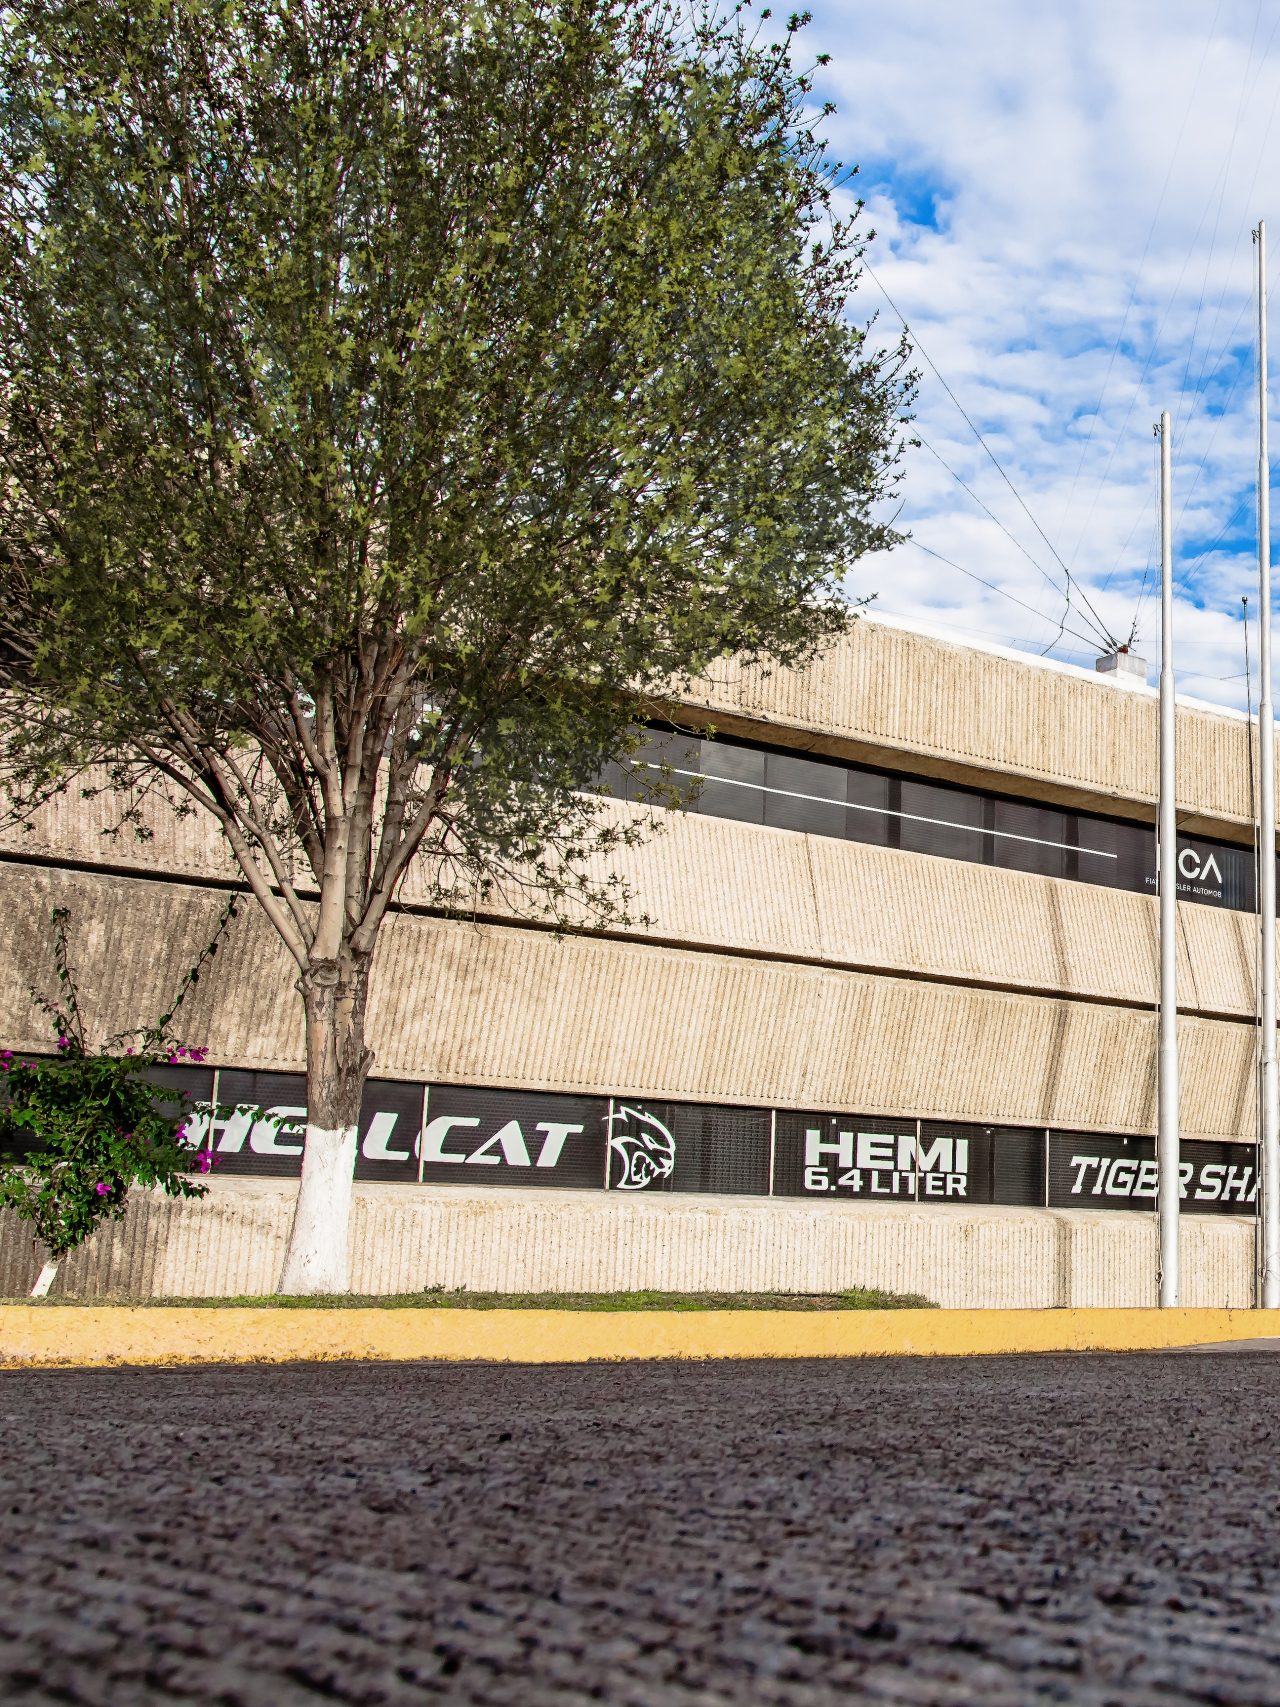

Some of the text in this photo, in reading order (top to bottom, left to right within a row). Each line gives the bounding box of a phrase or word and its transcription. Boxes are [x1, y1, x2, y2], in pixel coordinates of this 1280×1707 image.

[1156, 843, 1223, 884] CA
[180, 1102, 584, 1167] HELCAT
[804, 1130, 969, 1174] HEMI
[804, 1168, 968, 1196] 6.4 LITER
